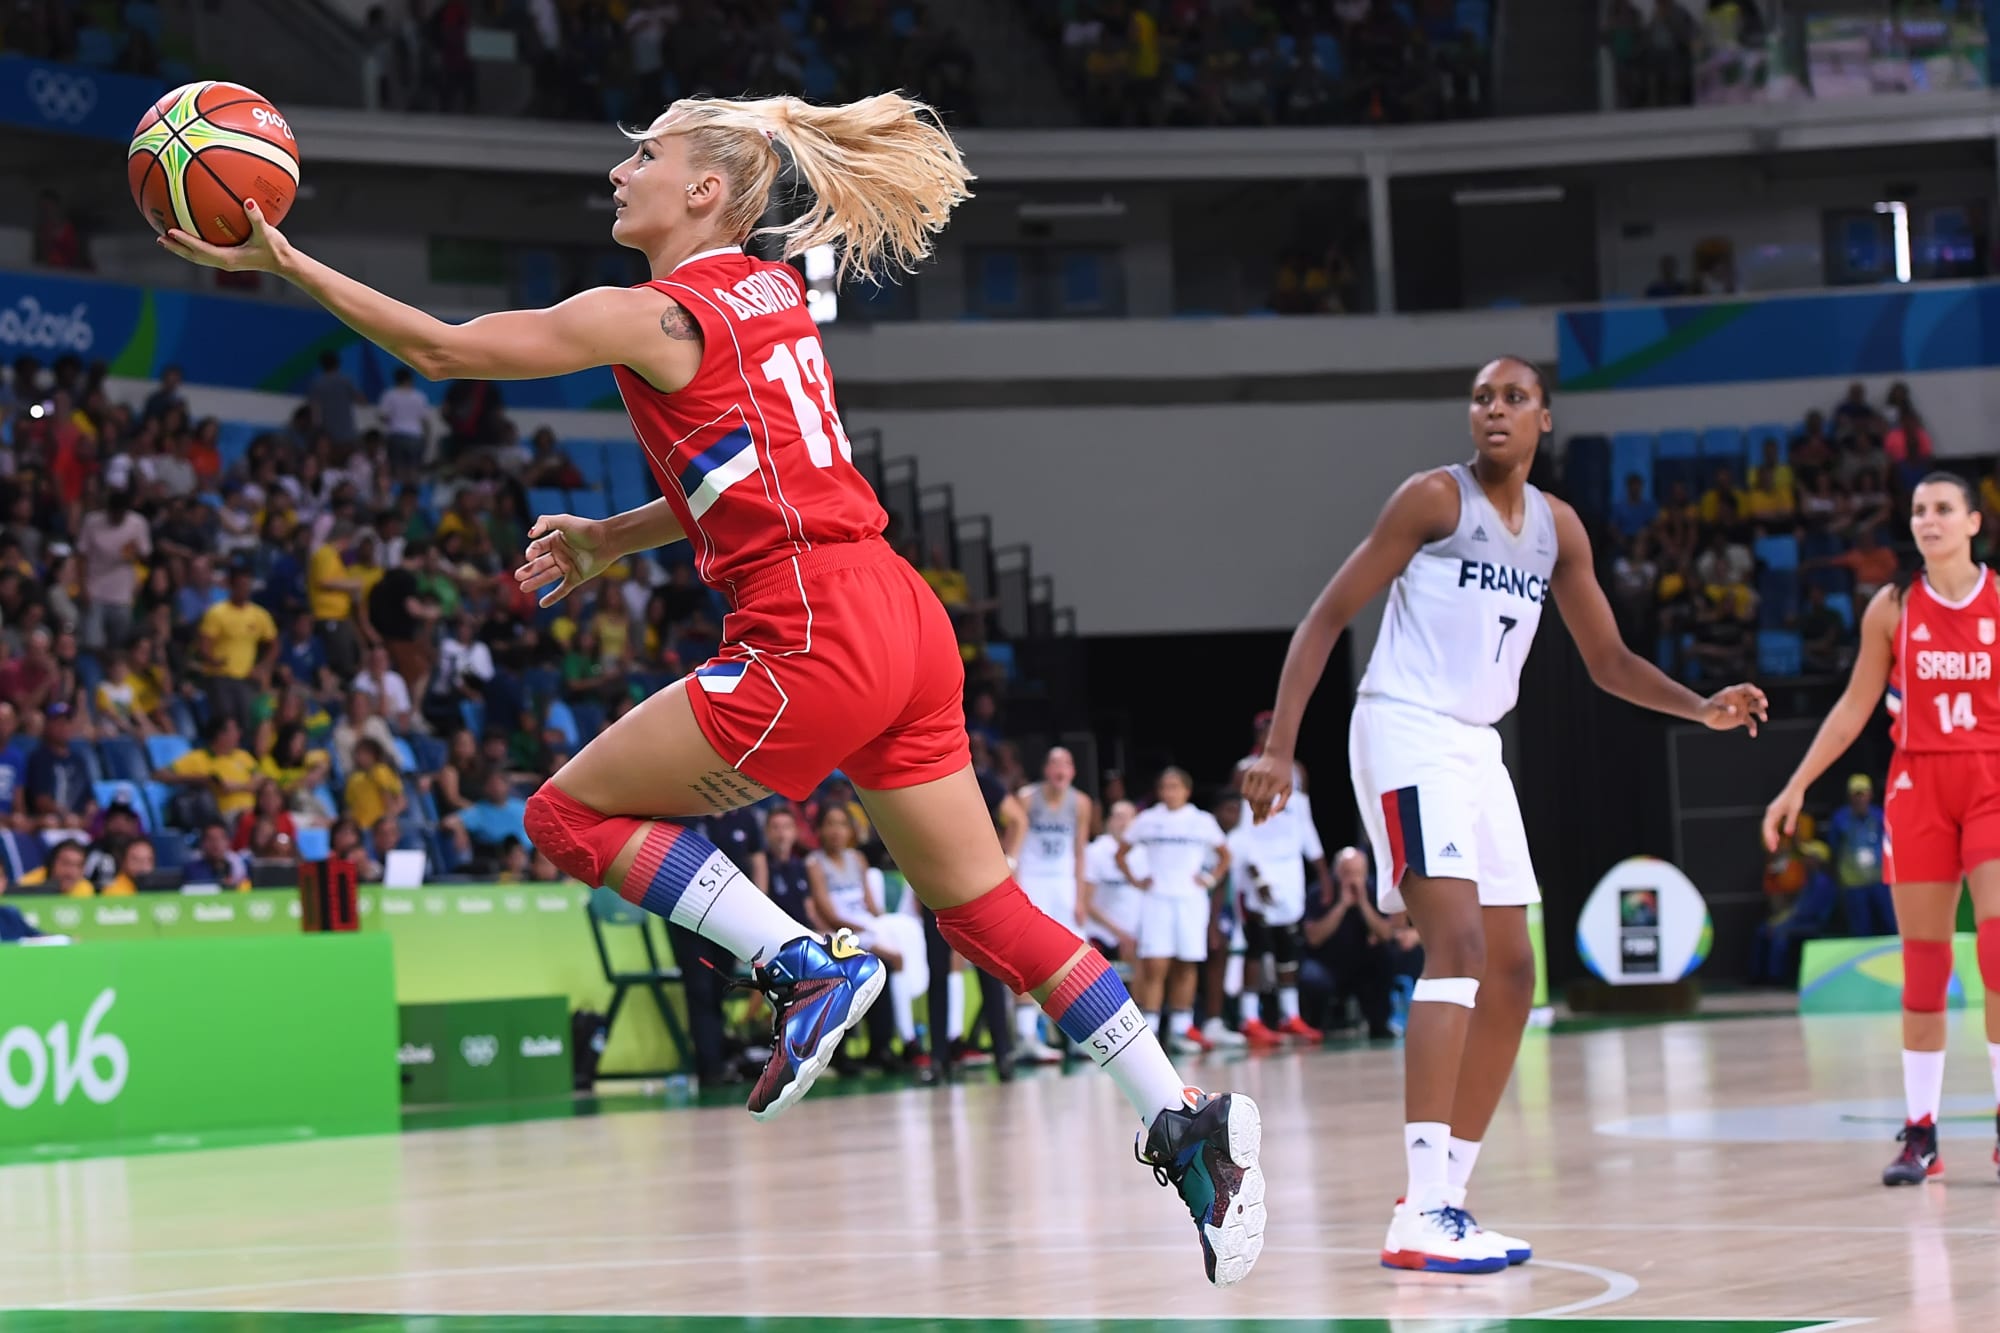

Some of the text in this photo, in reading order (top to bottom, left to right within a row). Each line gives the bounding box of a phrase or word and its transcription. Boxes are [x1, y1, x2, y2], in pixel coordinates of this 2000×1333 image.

[761, 336, 851, 468] 13
[1458, 559, 1550, 606] FRANCE
[1495, 615, 1518, 663] 7
[1933, 692, 1977, 733] 14
[1093, 1009, 1144, 1055] SRBI
